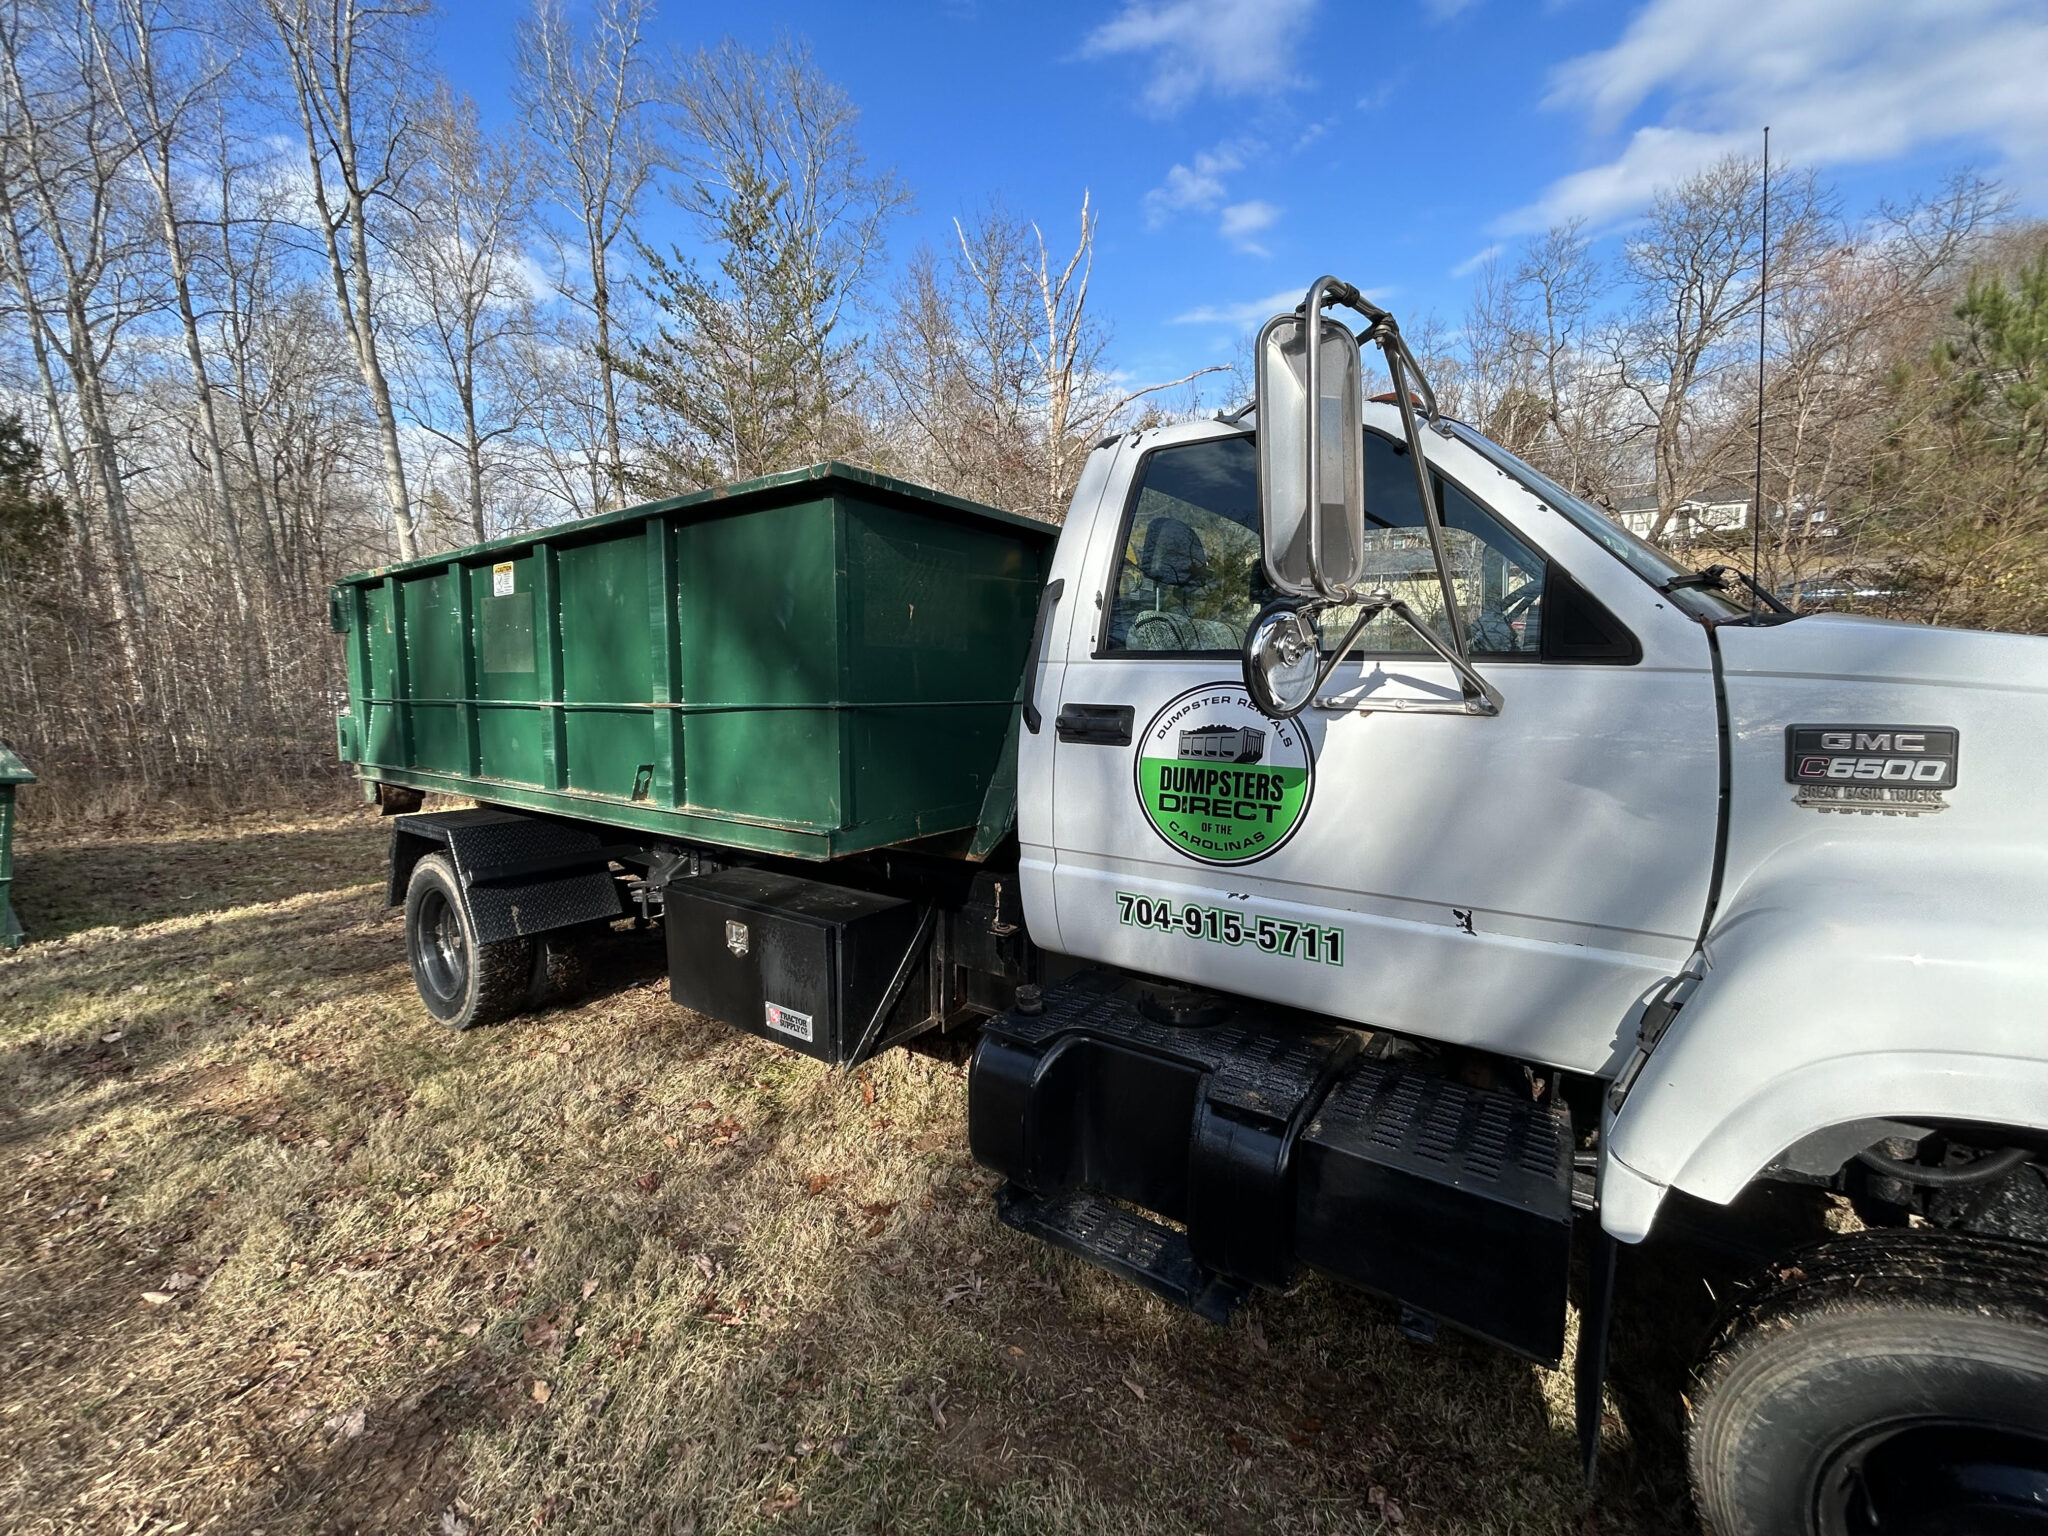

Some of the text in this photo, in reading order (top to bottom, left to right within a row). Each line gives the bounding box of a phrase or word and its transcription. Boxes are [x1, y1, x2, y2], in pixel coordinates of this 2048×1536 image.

[1157, 696, 1293, 748] DUMPSTER REALS
[1821, 732, 1925, 751] GMC
[1798, 757, 1947, 781] C6500
[1160, 766, 1284, 802] DUMPSTERS
[1799, 785, 1839, 799] GREAT
[1889, 788, 1943, 802] TRUCKS
[1159, 793, 1282, 823] DIRECT
[1169, 821, 1265, 852] CAROLINAS
[1201, 822, 1232, 835] OF THE
[1116, 891, 1344, 966] 704-915-5711
[780, 1012, 807, 1027] TRACTOR
